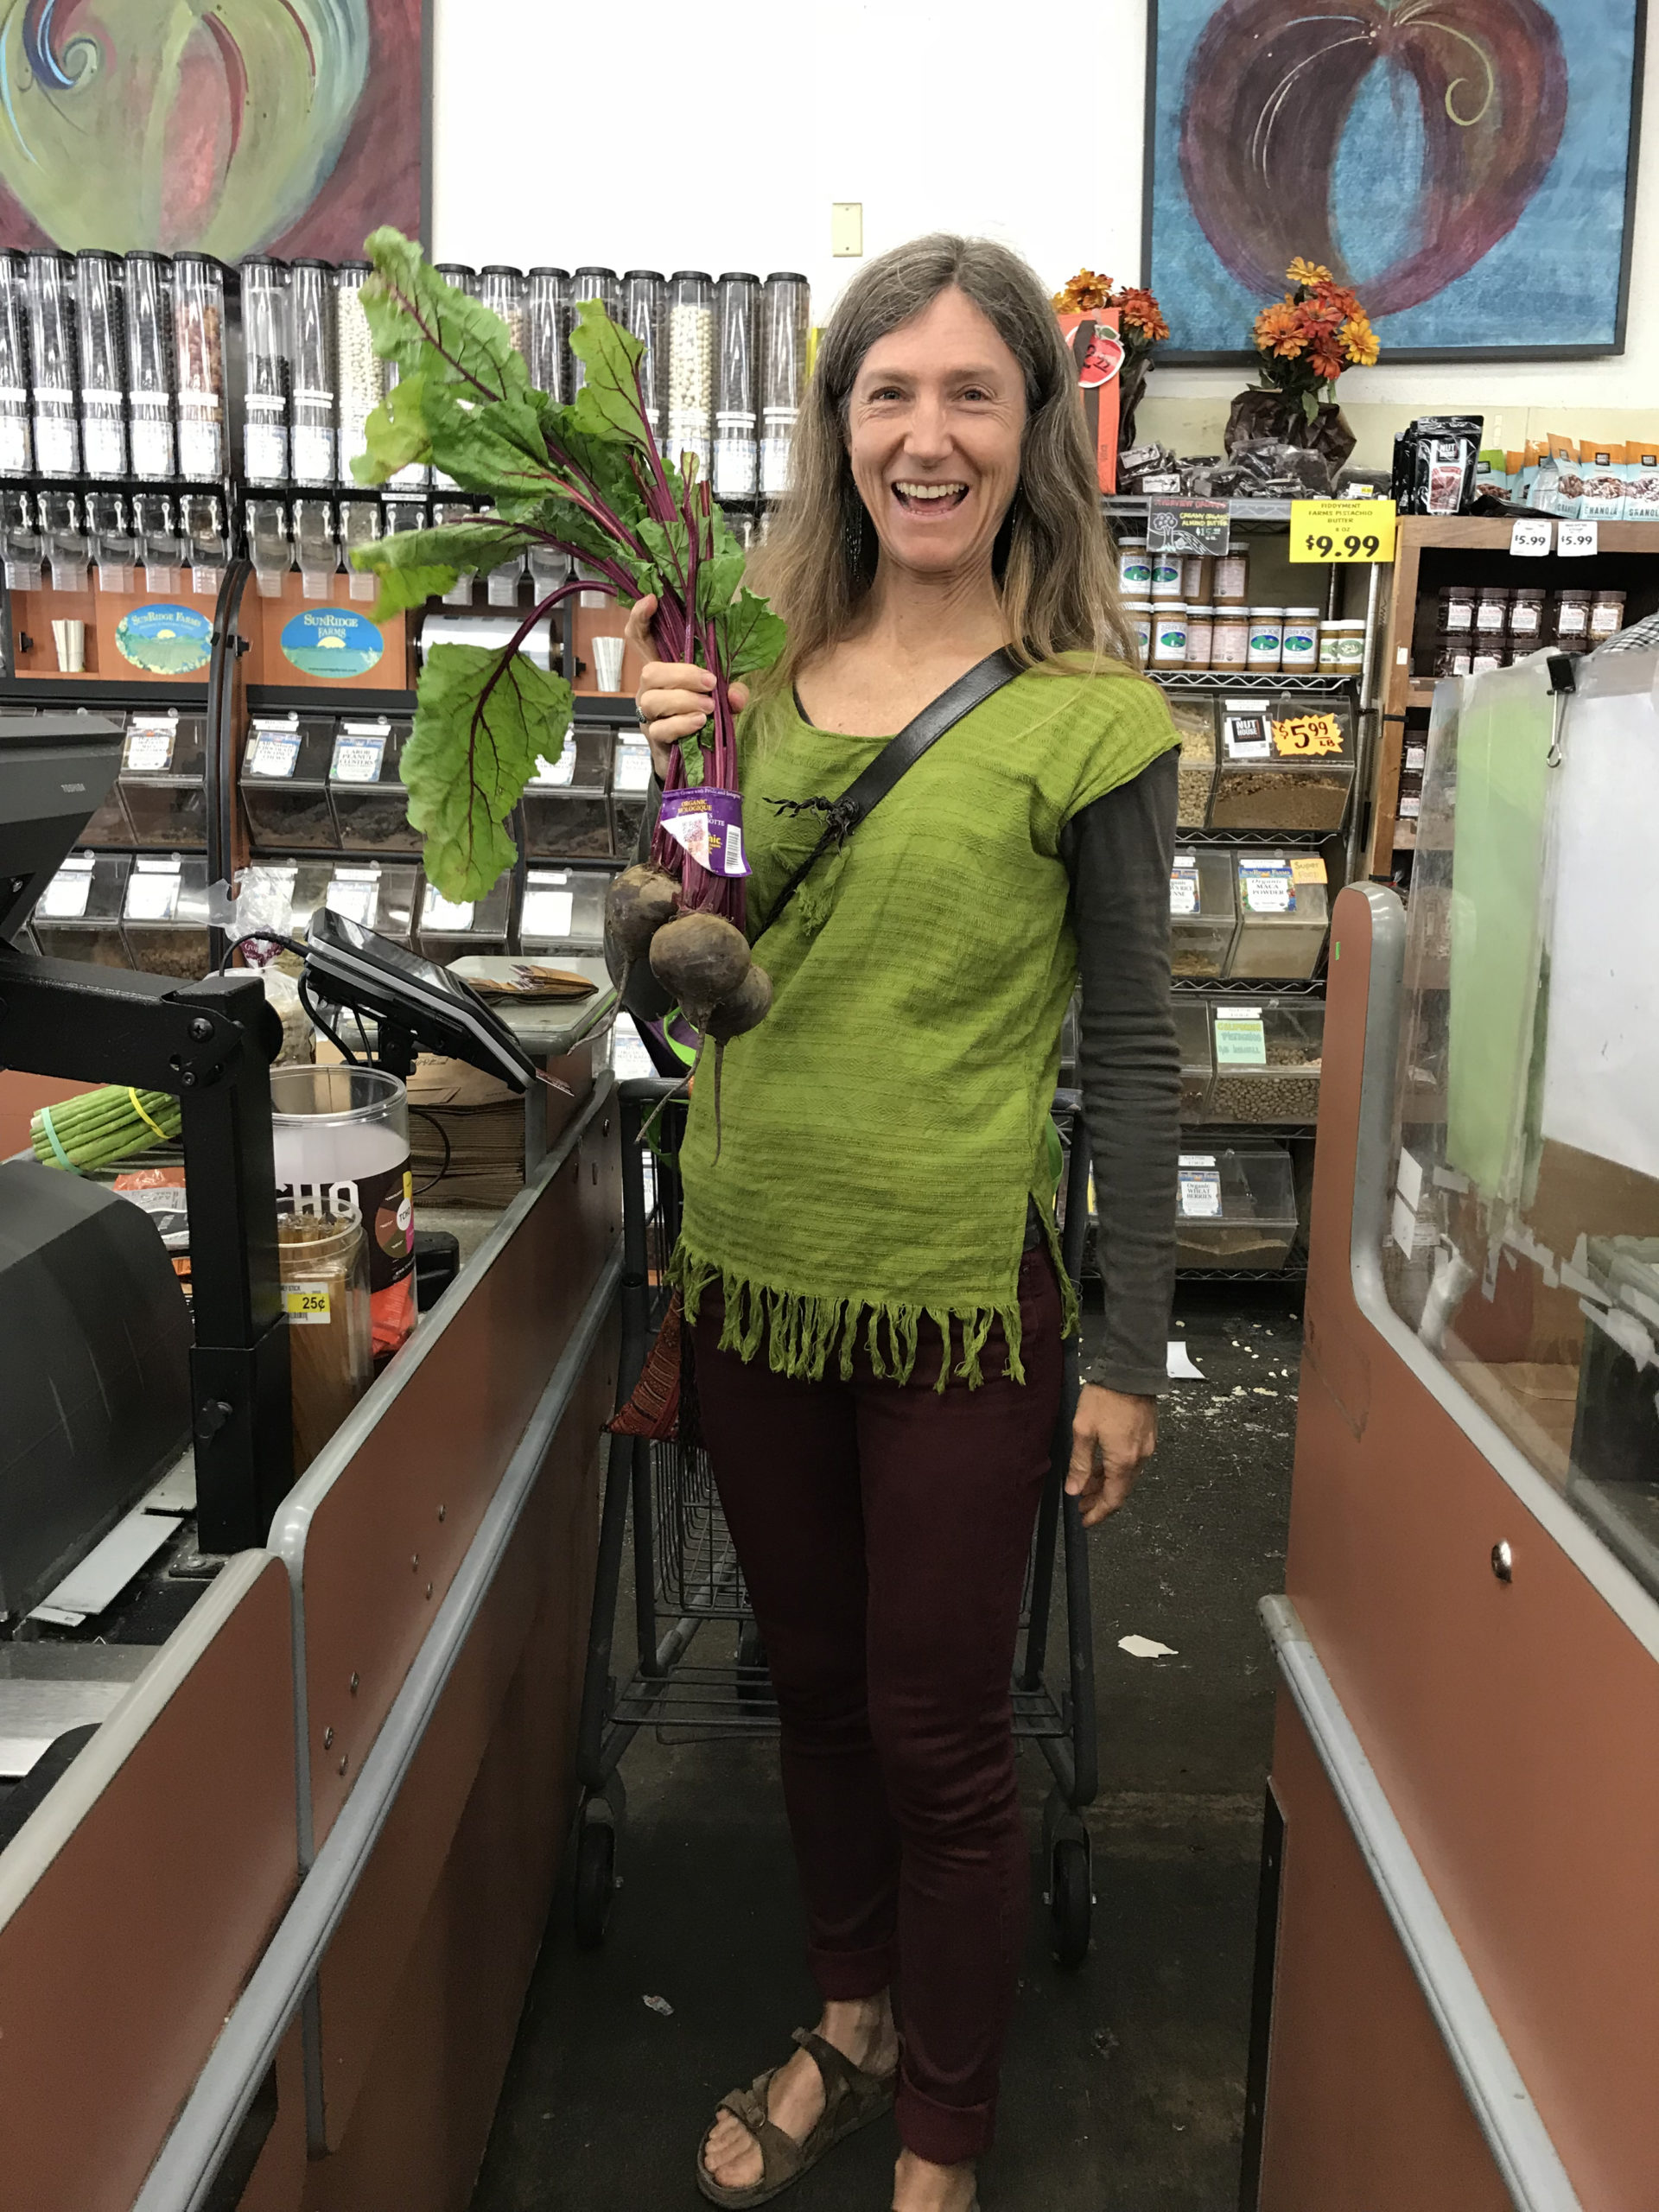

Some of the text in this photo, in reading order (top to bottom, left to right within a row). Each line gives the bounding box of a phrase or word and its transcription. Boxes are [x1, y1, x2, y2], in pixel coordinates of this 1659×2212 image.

[1439, 443, 1456, 452] NUT
[1629, 508, 1659, 517] GRANOL
[1515, 535, 1546, 545] $5.99
[1561, 536, 1592, 545] $5.99
[1306, 535, 1380, 558] $9.99
[318, 627, 346, 639] FARMS
[1236, 719, 1256, 729] NUT
[1236, 728, 1258, 736] HOUSE
[1319, 739, 1336, 747] LB
[681, 798, 708, 807] ORGANIC
[302, 1296, 326, 1312] 25¢
